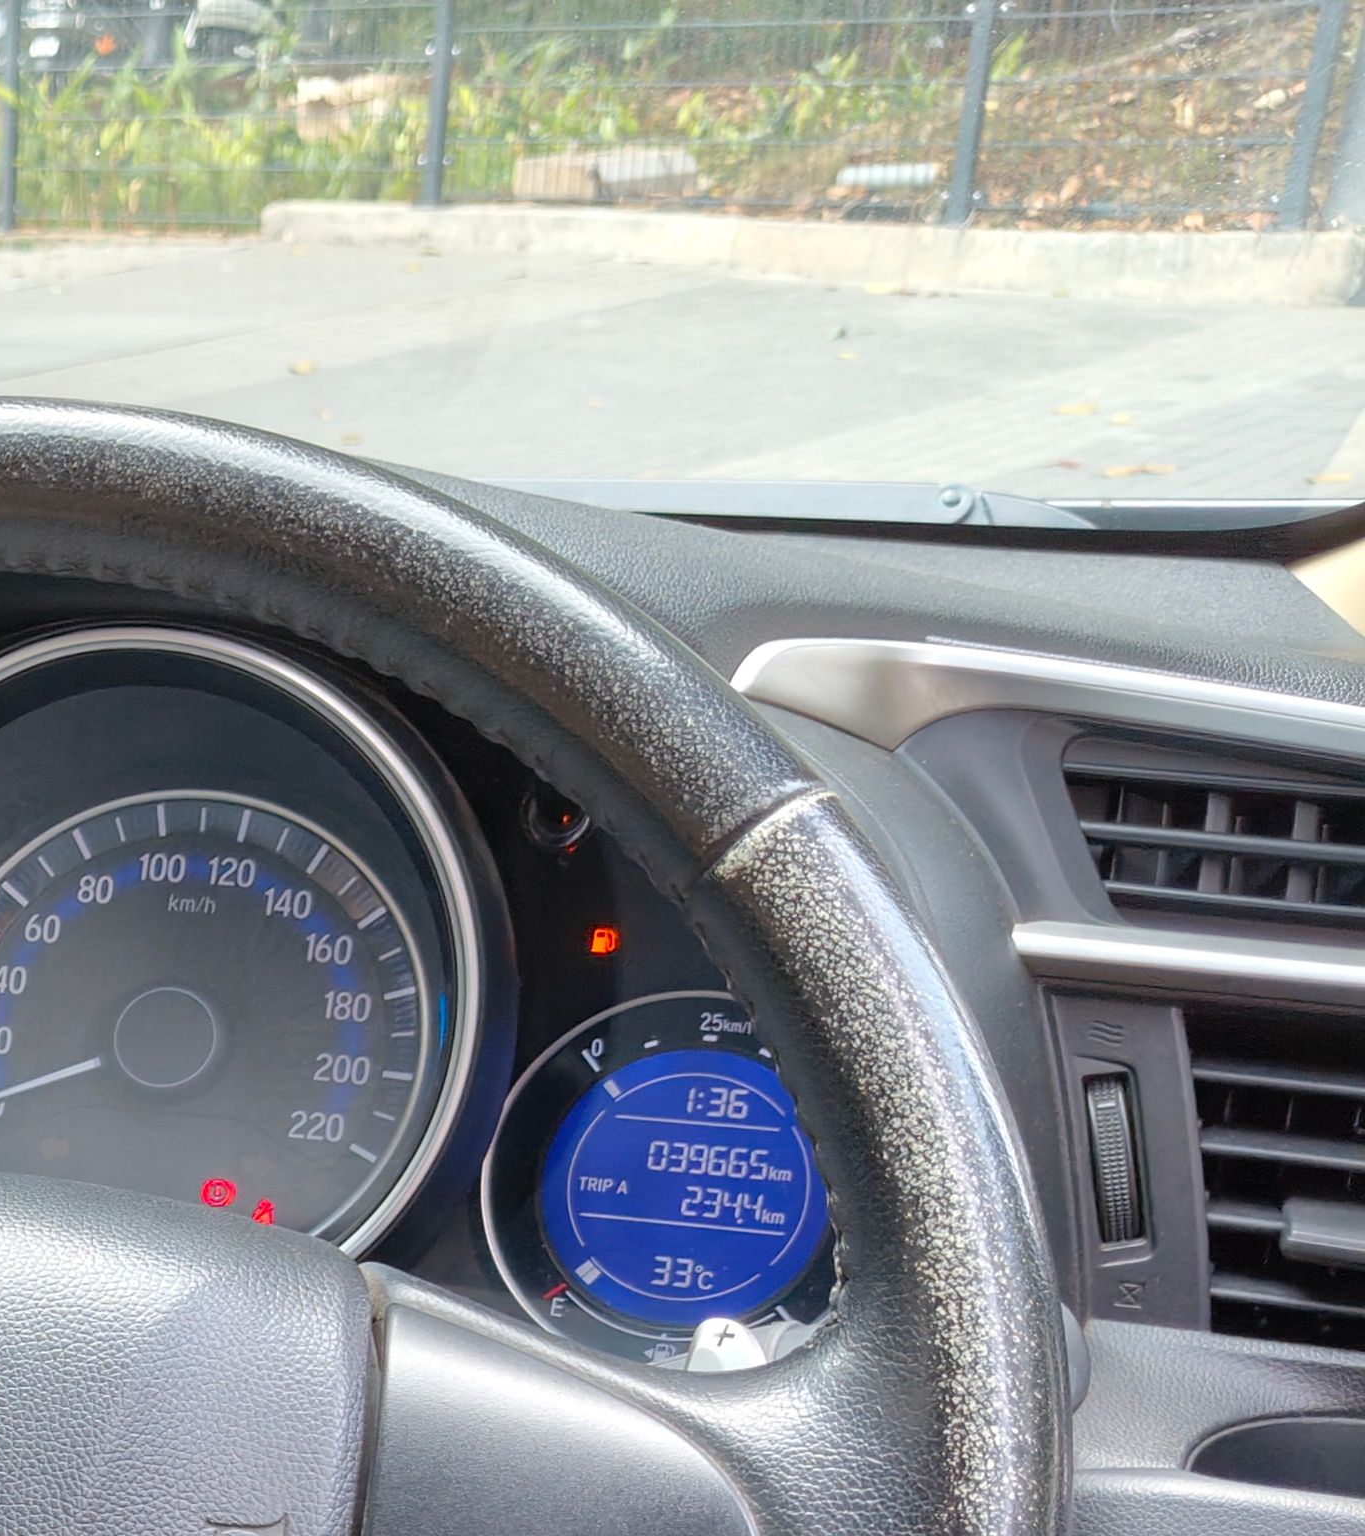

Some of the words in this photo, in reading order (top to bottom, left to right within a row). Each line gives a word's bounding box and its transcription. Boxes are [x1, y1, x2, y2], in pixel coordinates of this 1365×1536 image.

[139, 853, 186, 883] 100
[208, 857, 256, 888] 120
[77, 876, 114, 905] 80
[167, 894, 216, 914] km/h
[264, 888, 312, 920] 140
[24, 914, 60, 944] 60
[305, 934, 353, 966] 160
[325, 992, 371, 1022] 180
[313, 1053, 370, 1084] 200
[686, 1087, 749, 1119] 1:36
[288, 1110, 345, 1142] 220
[579, 1176, 613, 1193] TRIP
[616, 1180, 628, 1194] A
[550, 1297, 567, 1317] E
